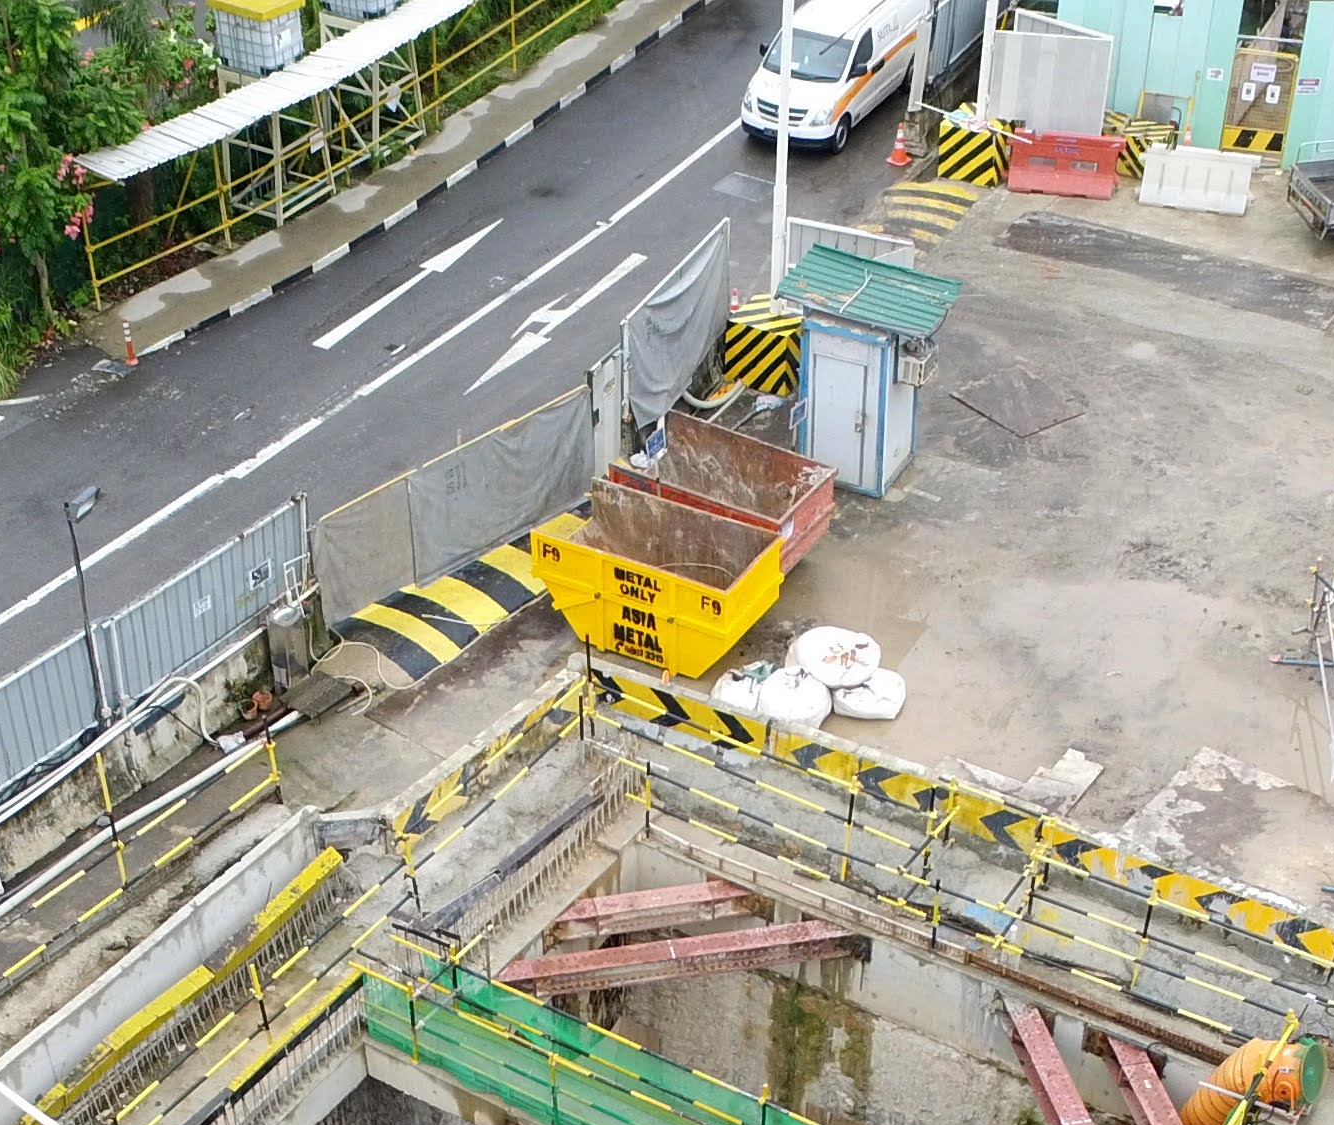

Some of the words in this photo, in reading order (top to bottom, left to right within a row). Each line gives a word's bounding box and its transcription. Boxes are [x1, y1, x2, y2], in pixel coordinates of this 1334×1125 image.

[542, 543, 561, 563] F9
[614, 567, 662, 593] METAL
[619, 583, 656, 604] ONLY
[701, 595, 722, 616] F9
[621, 605, 657, 632] ASIA
[613, 622, 663, 654] METAL
